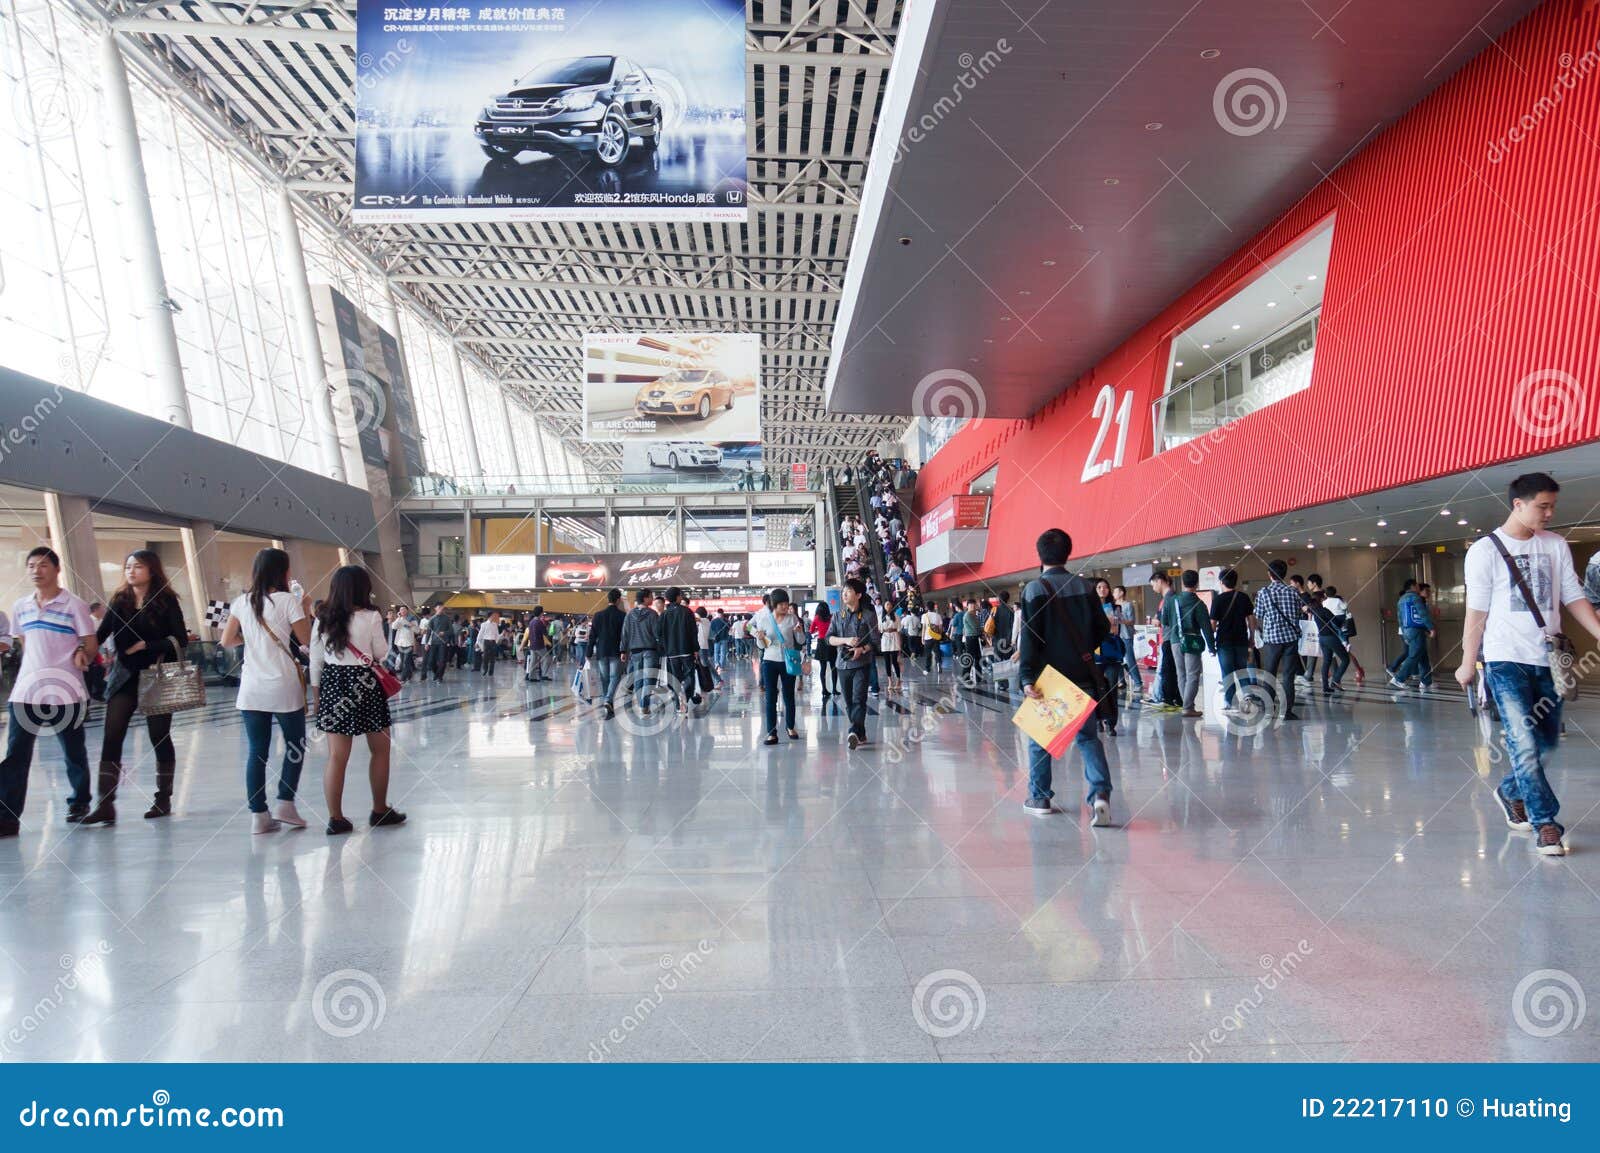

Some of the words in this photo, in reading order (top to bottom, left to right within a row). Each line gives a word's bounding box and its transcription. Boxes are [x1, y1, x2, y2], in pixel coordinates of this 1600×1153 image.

[384, 7, 471, 21] 沉淀岁月精华
[479, 7, 566, 21] 成就价值典范
[359, 195, 418, 205] CR-V
[607, 421, 622, 429] ARE
[624, 421, 657, 429] COMING
